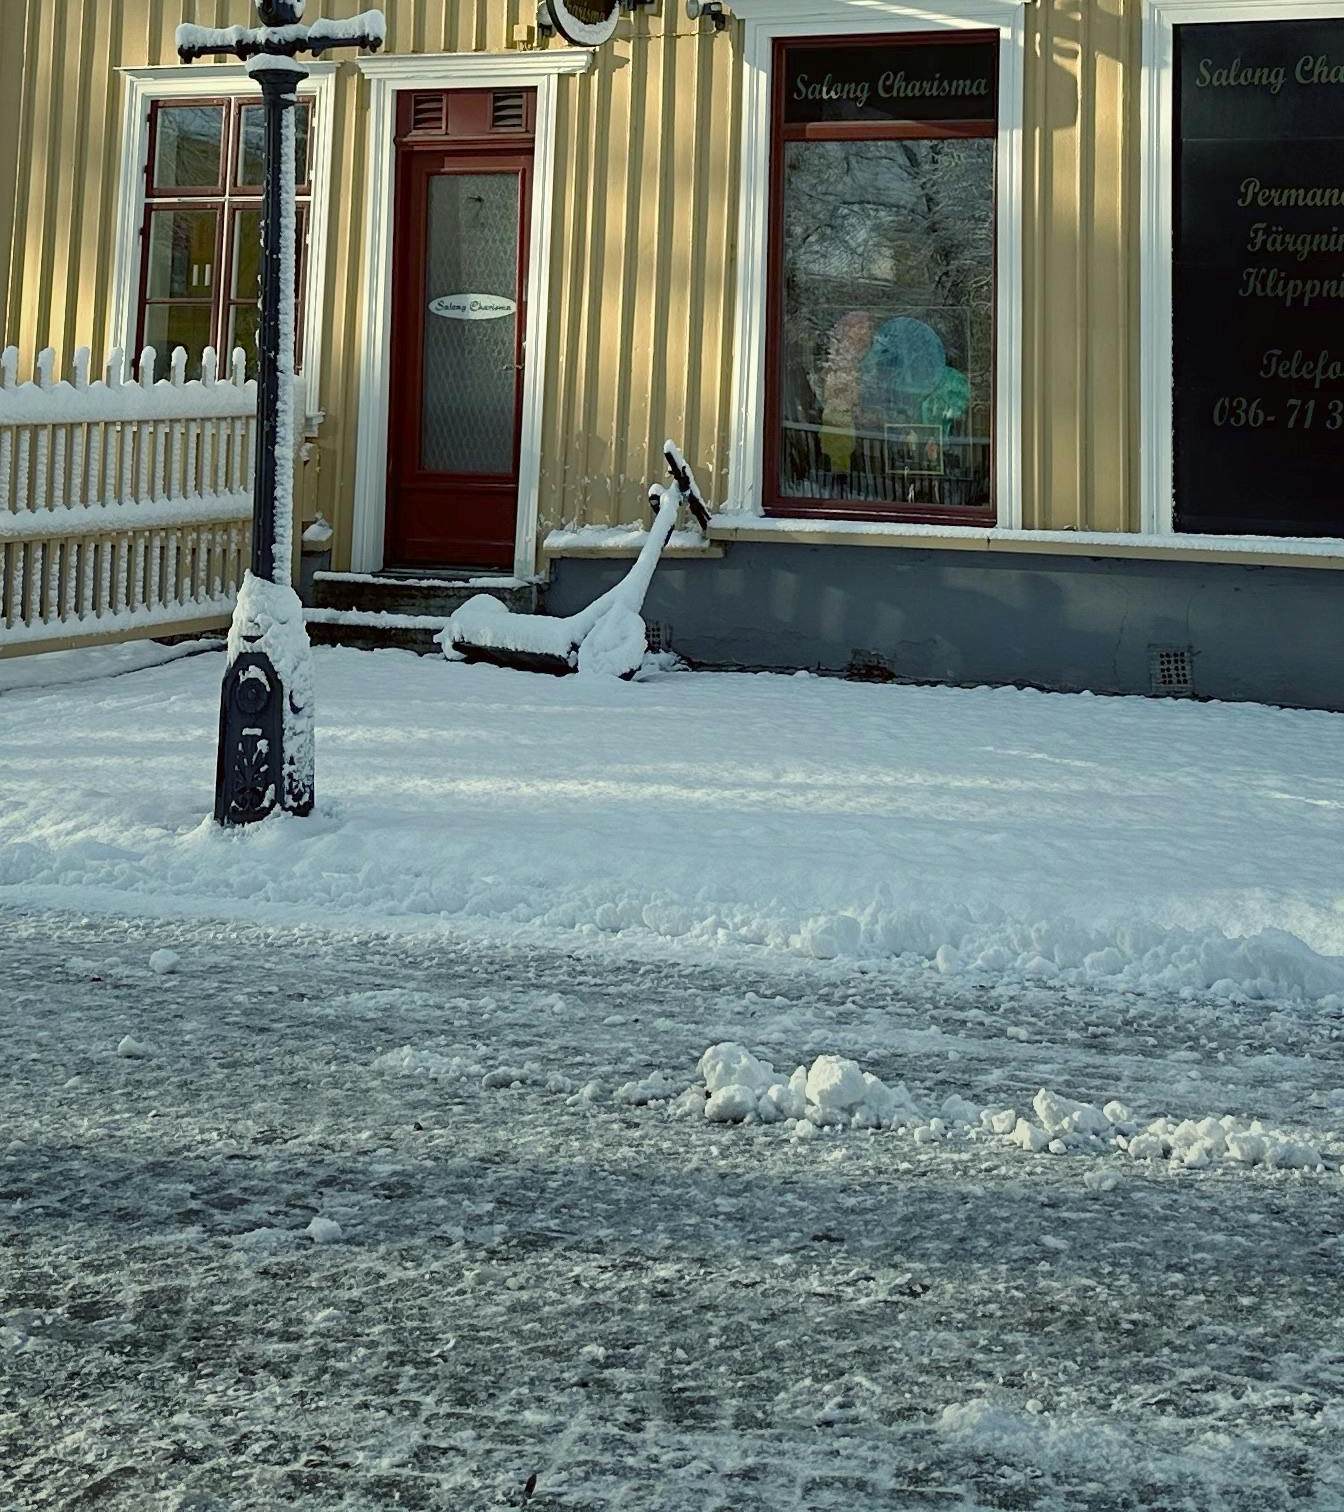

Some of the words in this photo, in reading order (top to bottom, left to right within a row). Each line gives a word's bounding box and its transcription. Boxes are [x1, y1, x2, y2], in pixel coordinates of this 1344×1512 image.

[793, 73, 870, 107] Salong
[877, 71, 990, 98] Charisma
[1196, 58, 1286, 94] Salong
[435, 300, 467, 312] Salong
[1213, 397, 1275, 428] 036-
[1286, 399, 1315, 429] 71
